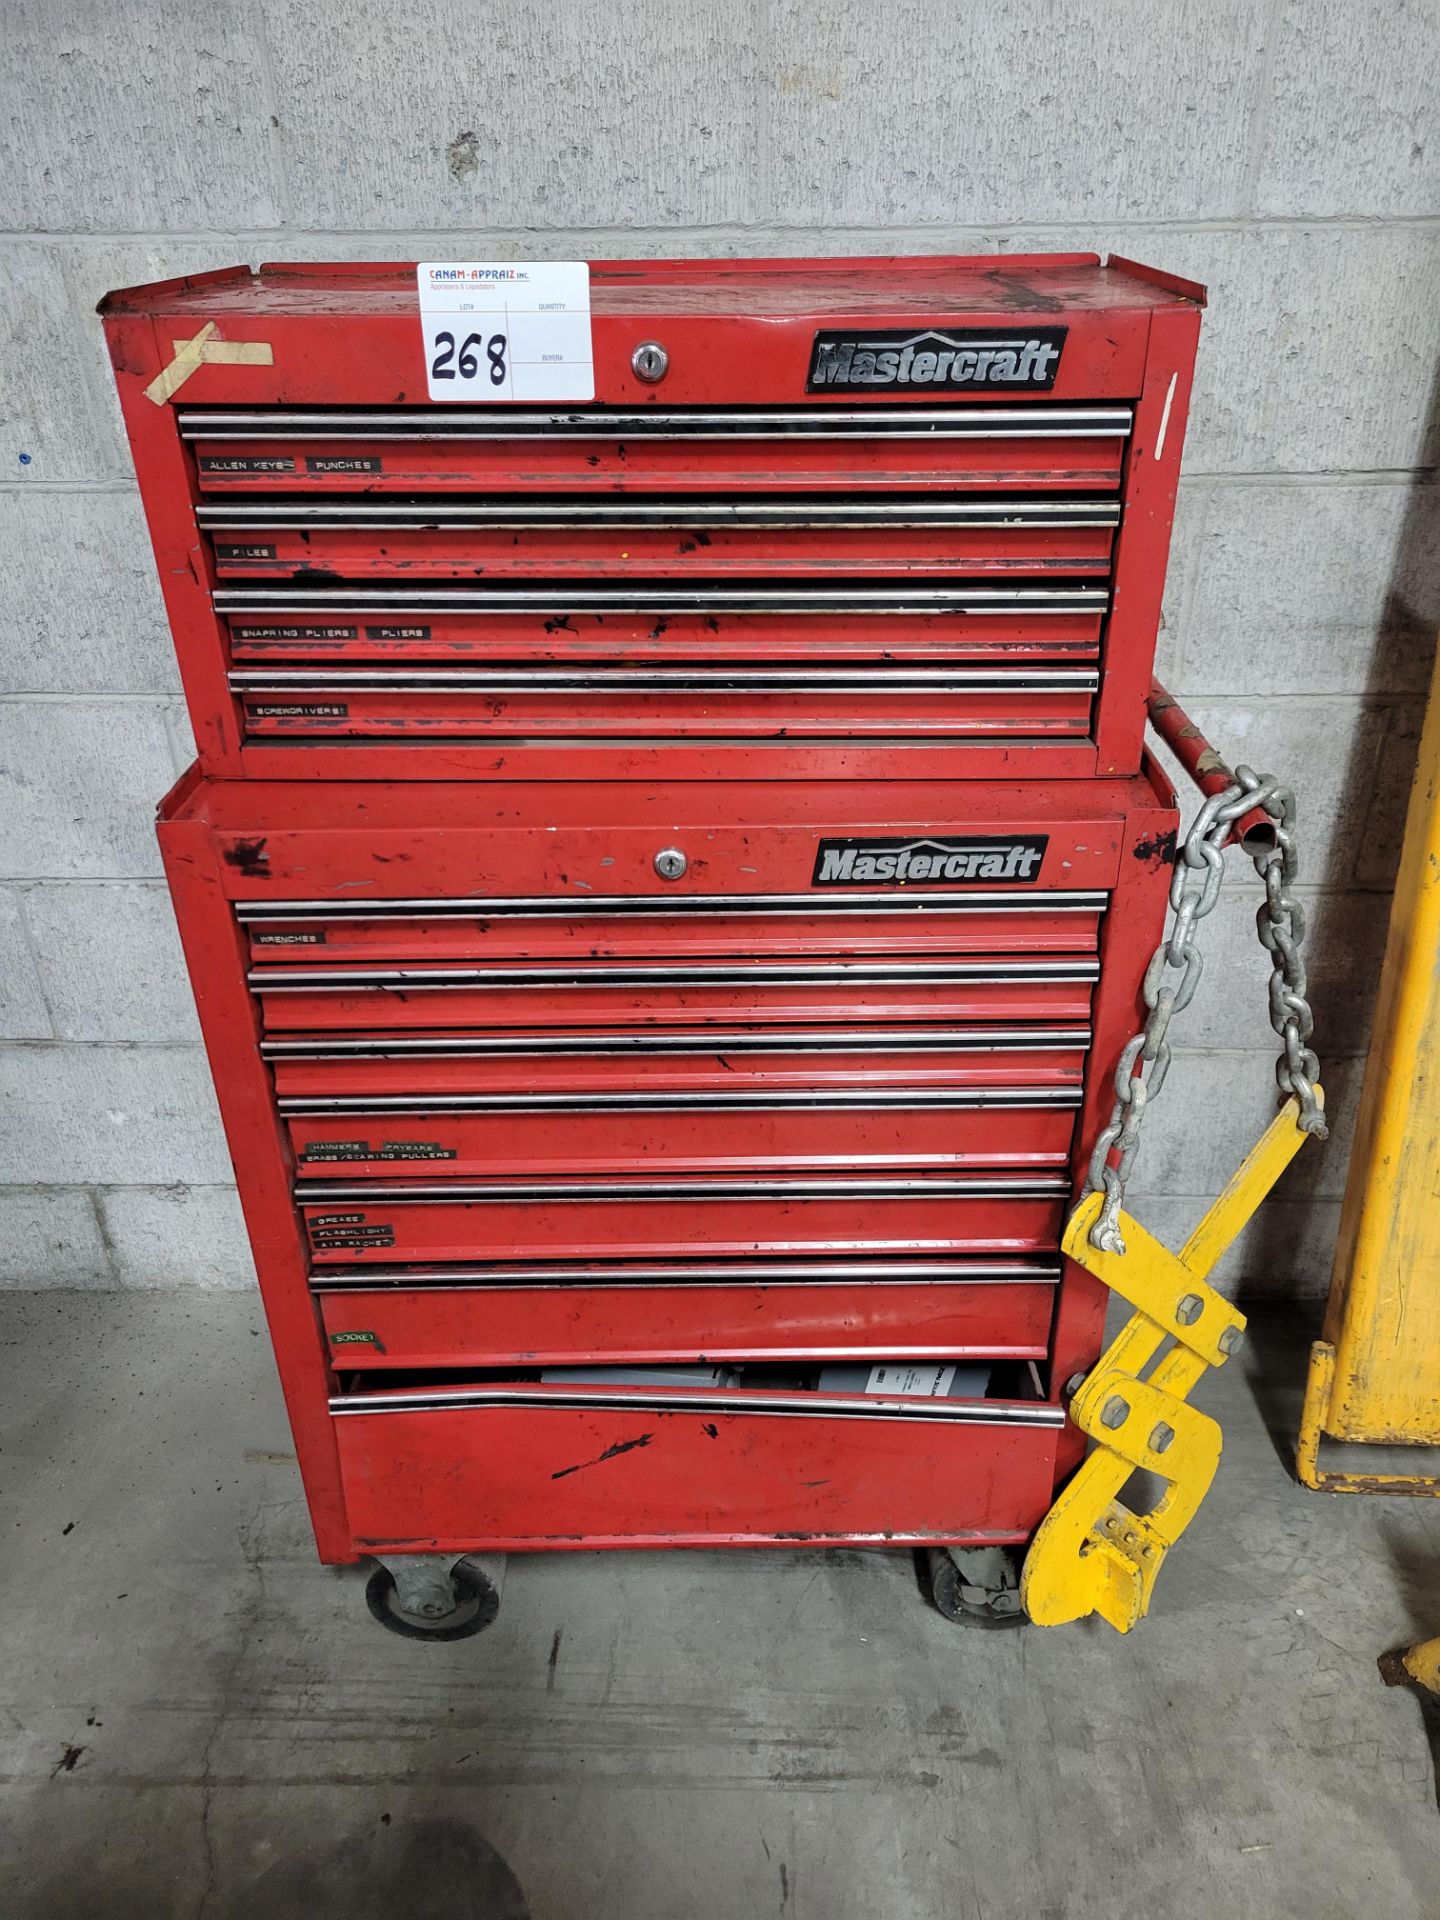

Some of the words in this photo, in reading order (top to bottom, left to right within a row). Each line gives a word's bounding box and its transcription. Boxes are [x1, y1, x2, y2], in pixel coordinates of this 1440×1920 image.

[429, 269, 515, 280] CANAM-APPRAIZ
[466, 283, 495, 291] Liquidators
[432, 331, 507, 386] 268
[813, 339, 1059, 384] Mastercraft
[210, 461, 248, 471] ALLEN
[253, 461, 284, 471] KEYS
[316, 460, 372, 470] PUNCHES
[241, 629, 298, 638] SNAPRING
[305, 629, 350, 637] PLIERS
[381, 629, 424, 637] PLIERS
[256, 707, 340, 716] SCREWDRIVERS
[819, 845, 1042, 881] Mastercraft
[260, 935, 317, 944] WRENCHES
[313, 1143, 360, 1151] HAMMERS
[401, 1151, 450, 1159] PULLERS
[318, 1216, 359, 1225] GREASE
[319, 1228, 386, 1237] FLASHLIGHT
